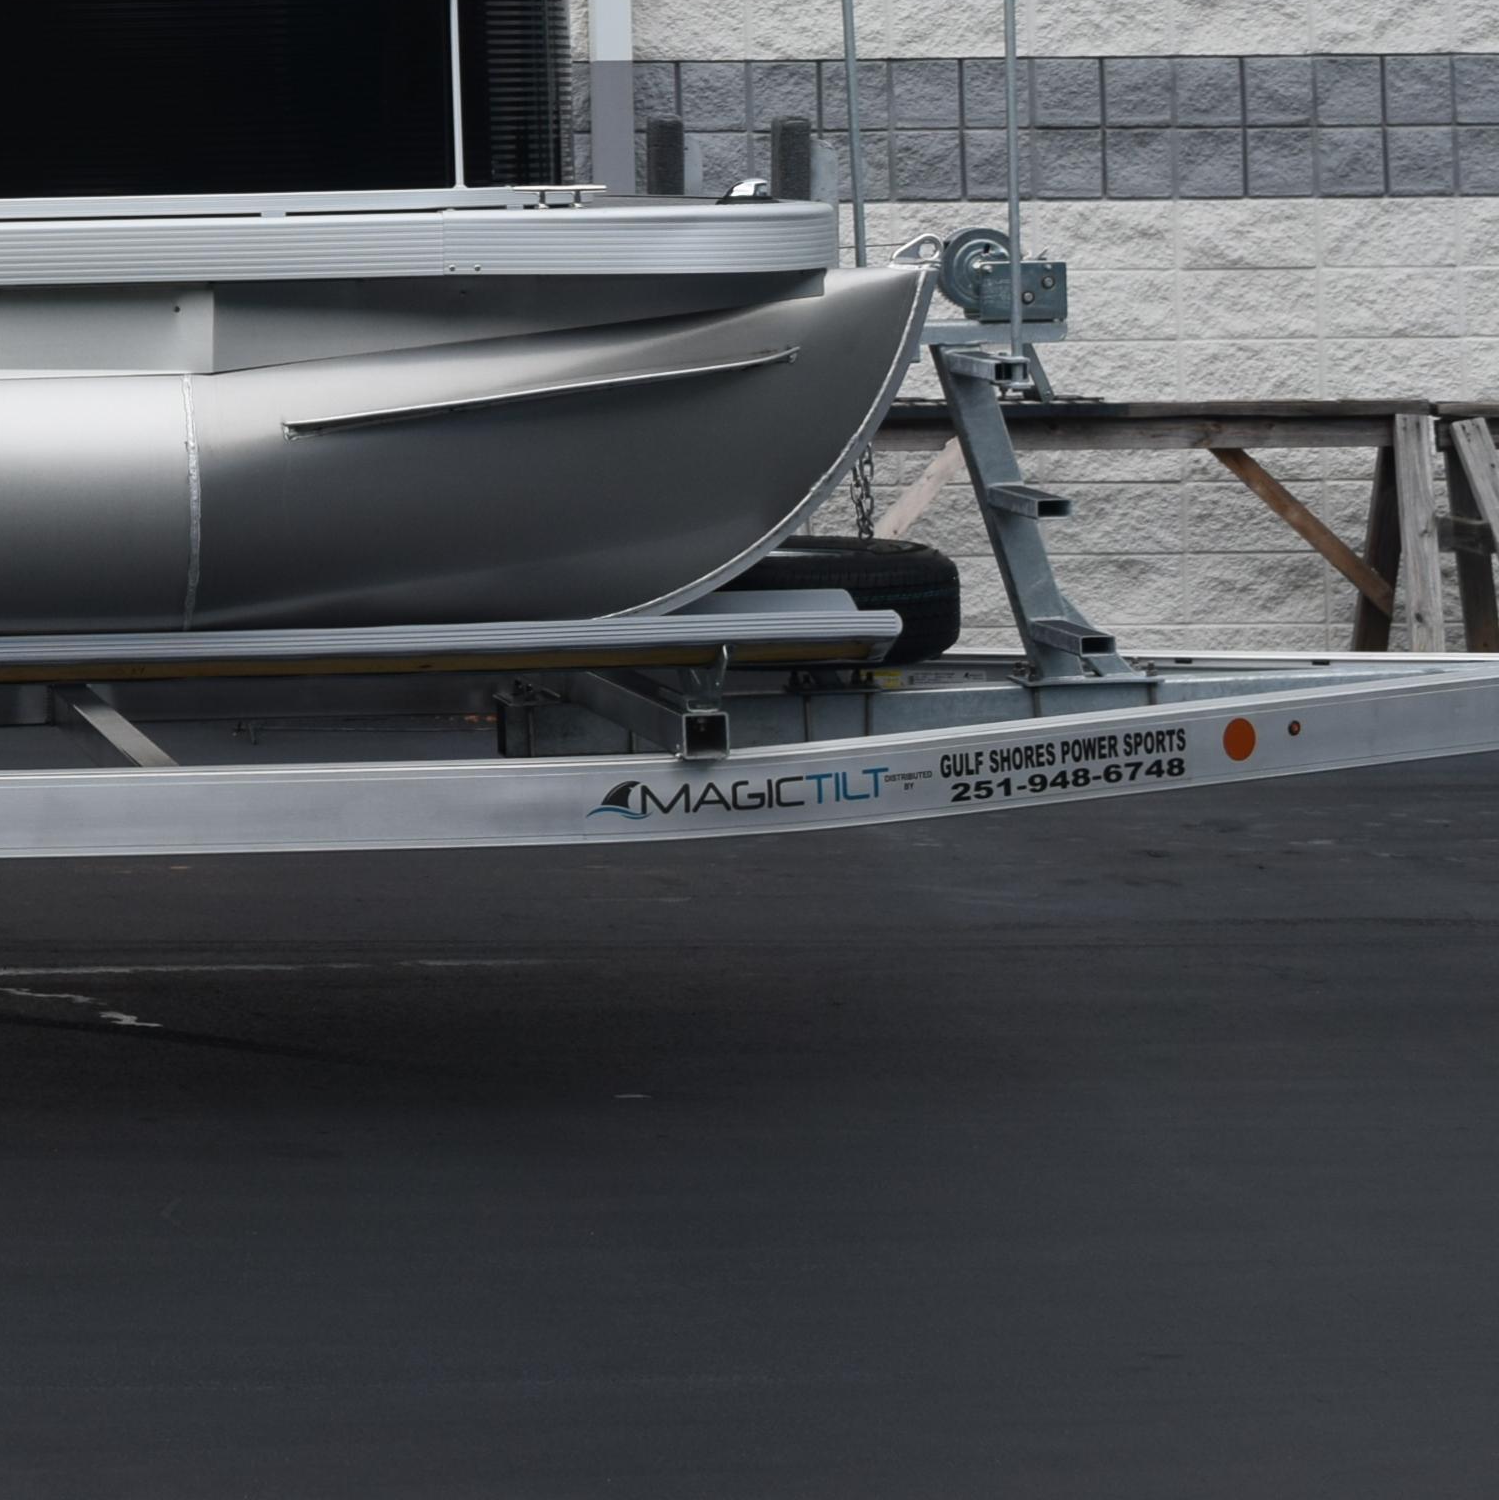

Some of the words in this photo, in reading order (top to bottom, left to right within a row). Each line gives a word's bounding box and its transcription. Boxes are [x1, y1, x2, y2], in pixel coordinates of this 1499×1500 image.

[940, 752, 984, 779] GULF
[989, 743, 1055, 774] SHORES
[1061, 736, 1118, 764] POWER
[1123, 728, 1187, 756] SPORTS
[884, 770, 933, 782] DISTRIBUTED
[904, 782, 915, 791] BY
[951, 758, 1186, 802] 251-948-6748
